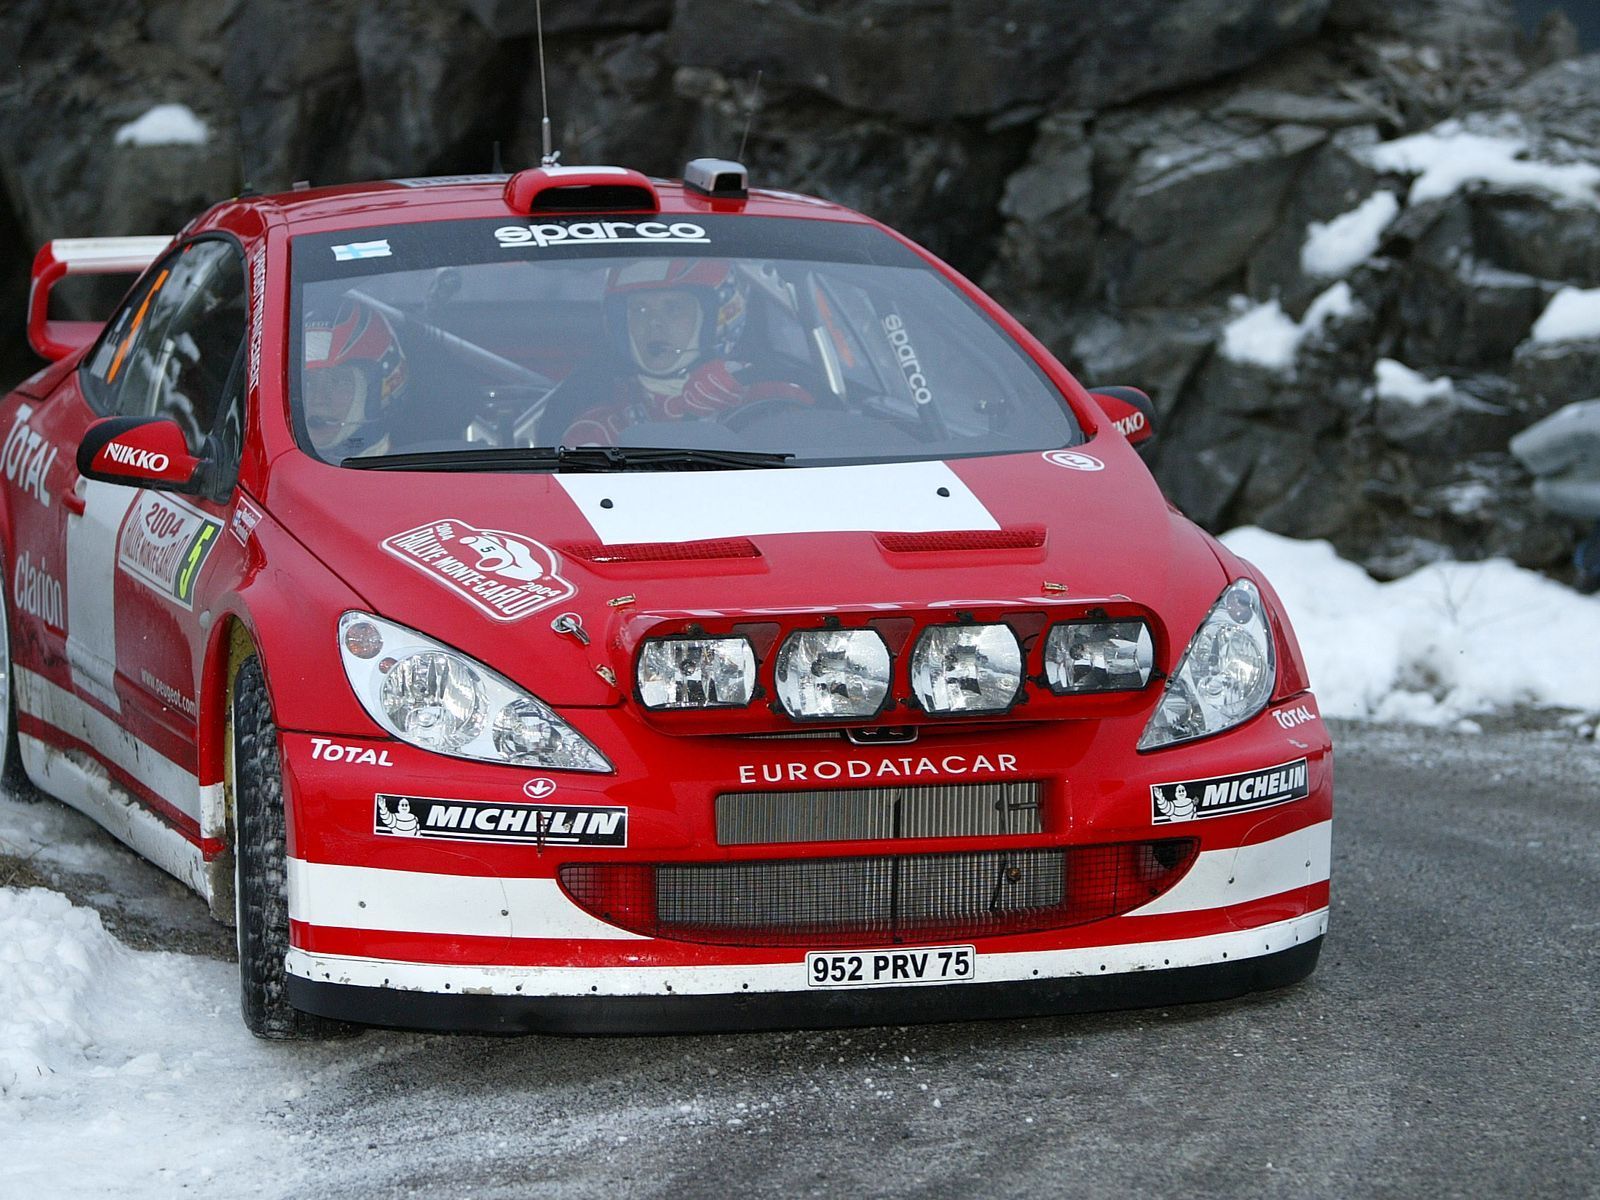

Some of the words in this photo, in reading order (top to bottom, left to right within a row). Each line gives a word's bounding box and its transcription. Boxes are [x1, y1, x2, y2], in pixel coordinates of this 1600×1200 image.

[494, 219, 711, 248] sparco
[881, 314, 932, 408] sparco
[1112, 411, 1145, 436] KKO
[0, 403, 58, 508] TOTAL
[103, 442, 169, 472] NIKKO
[145, 502, 185, 538] 2004
[435, 523, 455, 541] 2004
[391, 528, 449, 562] RALLYE
[480, 545, 496, 553] 5
[179, 525, 215, 599] 5
[14, 550, 64, 630] Clarion
[519, 582, 561, 597] 2004
[1272, 705, 1316, 730] TOTAL
[310, 738, 393, 767] TOTAL
[738, 753, 1019, 784] EURODATACAR
[1201, 764, 1306, 807] MICHELIN
[426, 804, 619, 835] MICHELIN
[813, 957, 864, 983] 952
[873, 953, 929, 980] PRV
[938, 951, 970, 977] 75
